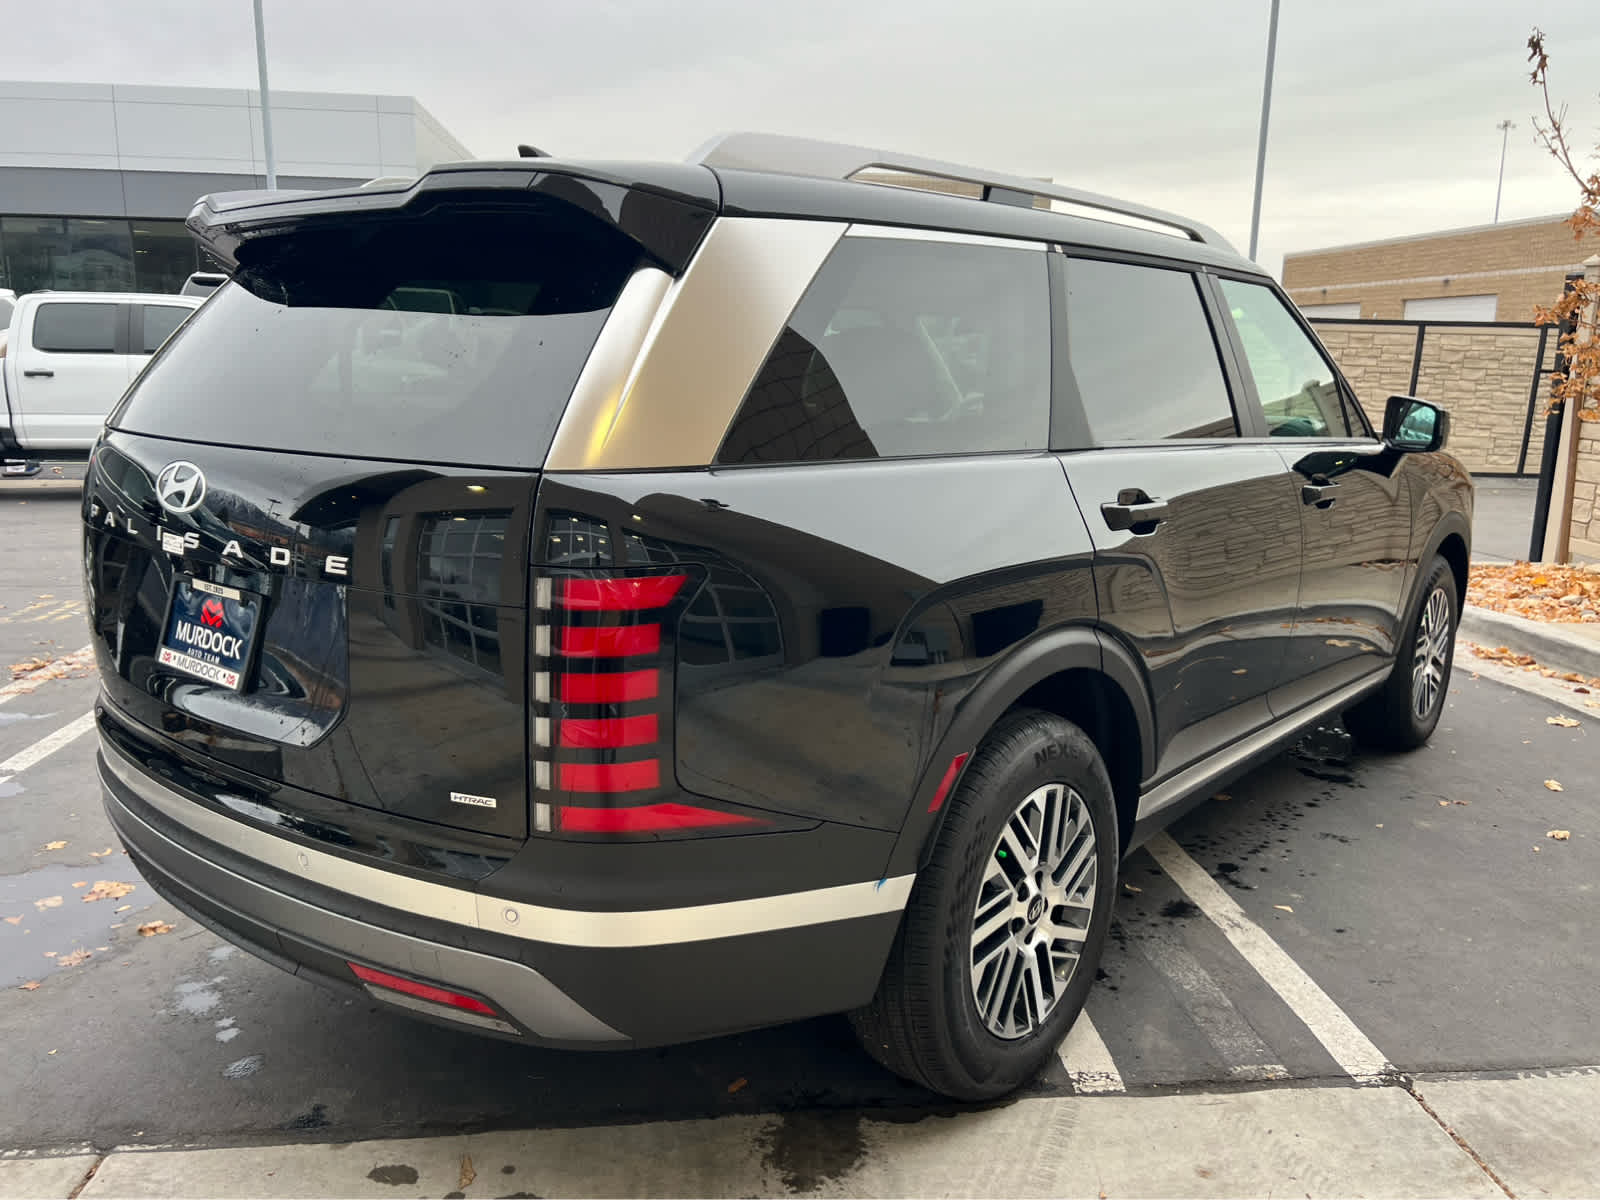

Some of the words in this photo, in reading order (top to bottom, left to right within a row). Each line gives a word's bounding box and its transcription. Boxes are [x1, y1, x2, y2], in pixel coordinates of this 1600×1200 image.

[91, 503, 349, 576] PALISADE
[175, 619, 243, 660] MURDOCK
[176, 655, 221, 681] MURDOCK
[187, 647, 203, 659] AUTO
[204, 652, 220, 665] TEAM
[453, 794, 494, 806] HTRAC
